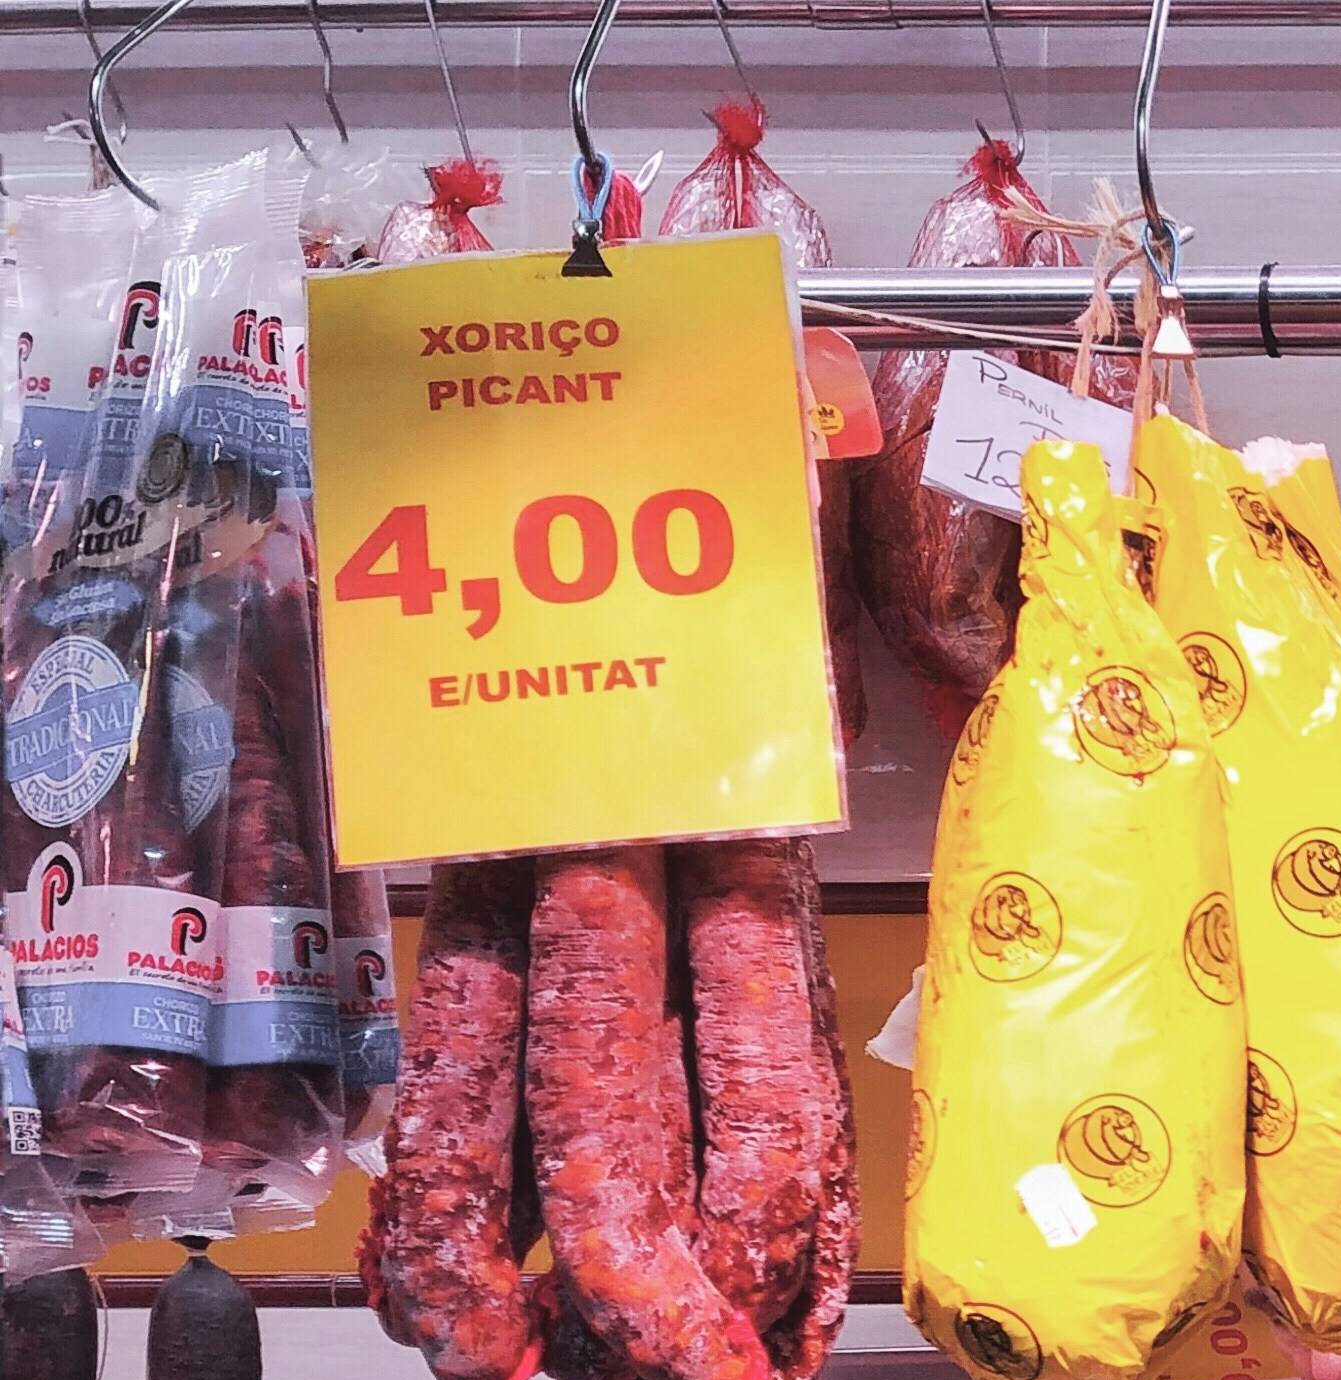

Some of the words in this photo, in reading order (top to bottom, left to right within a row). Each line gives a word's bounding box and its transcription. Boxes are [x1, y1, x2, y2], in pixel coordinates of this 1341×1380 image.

[420, 316, 621, 358] XORIÇO
[428, 371, 622, 411] PICANT
[971, 355, 1064, 425] PERNIL
[334, 488, 735, 640] 4,00
